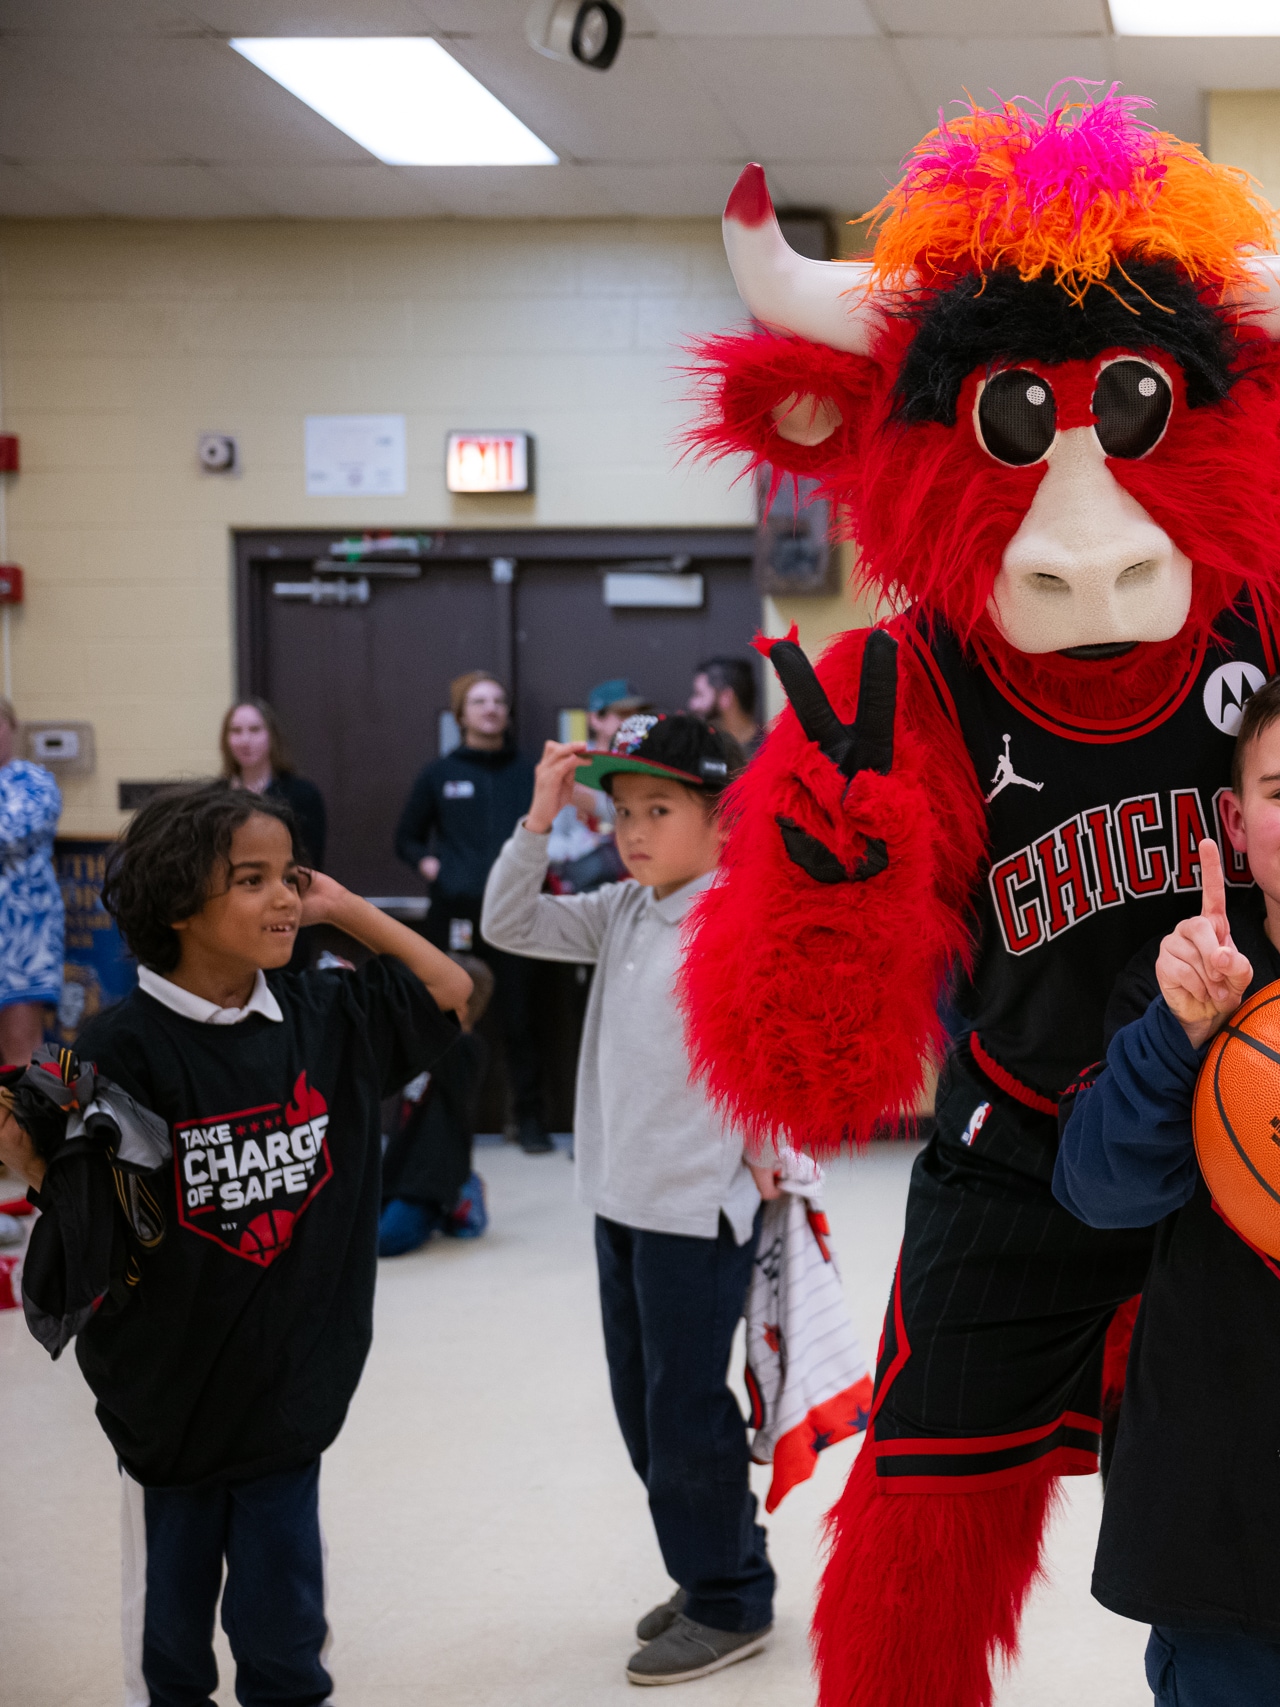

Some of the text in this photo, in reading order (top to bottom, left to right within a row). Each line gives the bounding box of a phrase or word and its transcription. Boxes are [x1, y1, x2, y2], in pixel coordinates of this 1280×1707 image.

[988, 787, 1257, 957] CHICA
[180, 1123, 232, 1150] TAKE
[187, 1159, 317, 1211] OF SAFET
